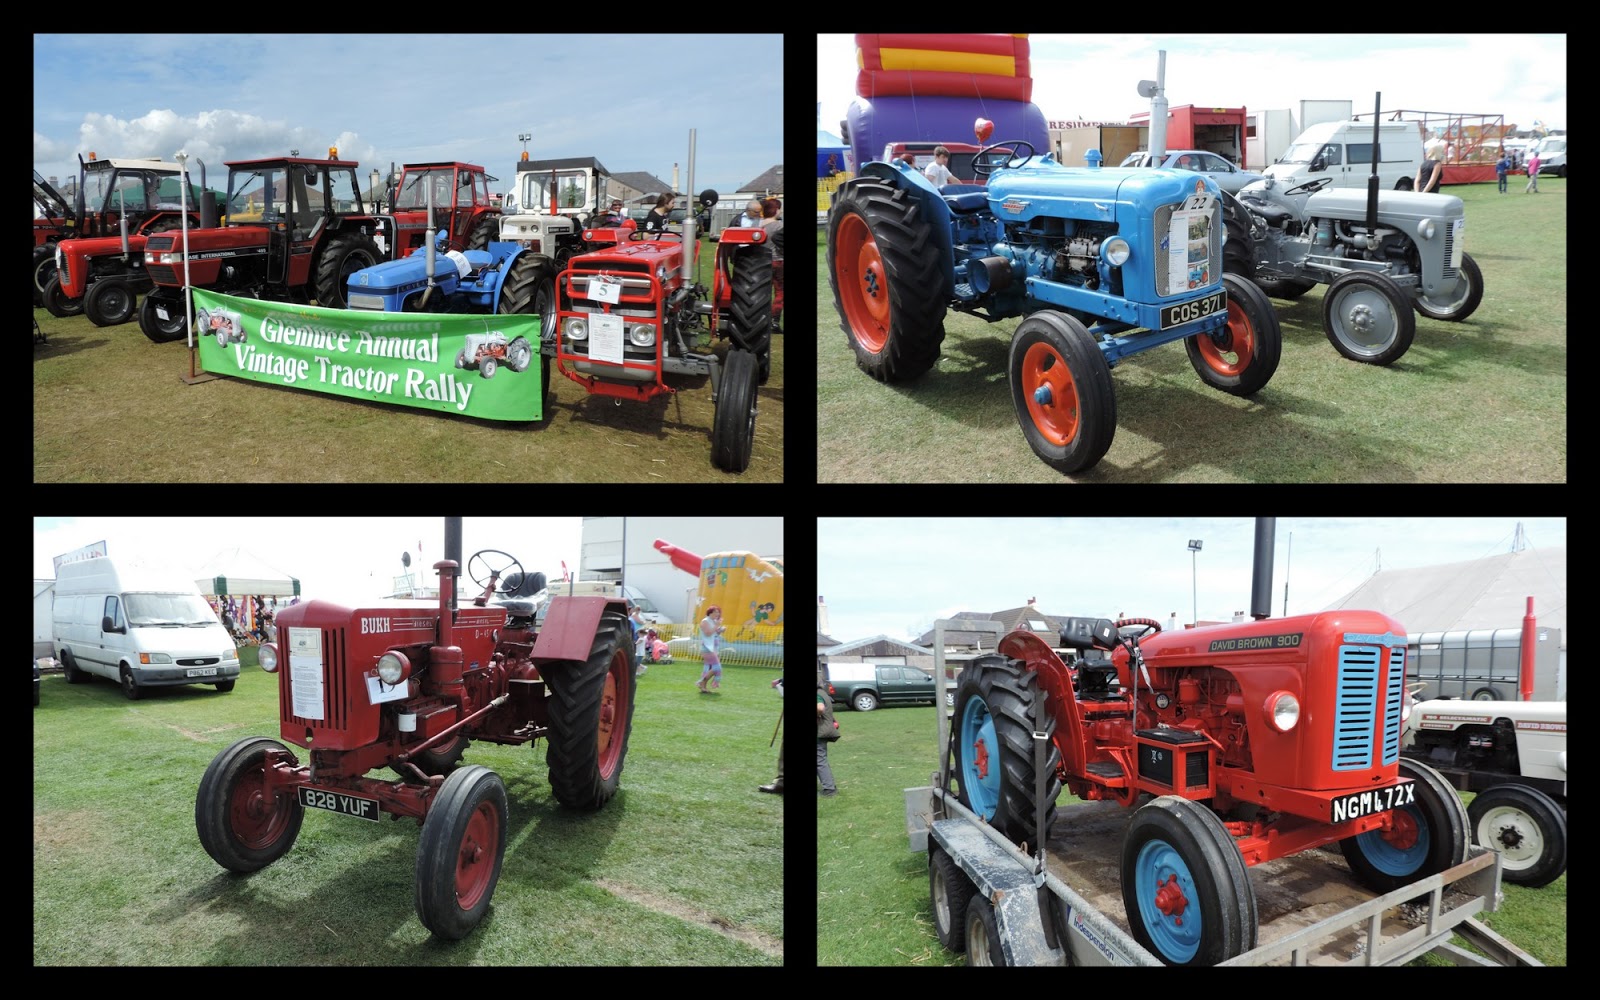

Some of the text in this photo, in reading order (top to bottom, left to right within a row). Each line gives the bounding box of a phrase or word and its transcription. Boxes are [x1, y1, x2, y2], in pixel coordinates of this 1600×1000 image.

[1191, 197, 1207, 210] 22
[201, 251, 236, 259] INTERNATIONAL
[599, 284, 608, 296] 5
[1171, 295, 1221, 325] COS 371
[355, 330, 439, 363] Annual
[234, 343, 473, 411] Vintage Tractor Rally
[361, 617, 391, 634] BUKH
[1211, 634, 1300, 651] DAVID BROWN 900
[306, 790, 371, 816] 828 YUF
